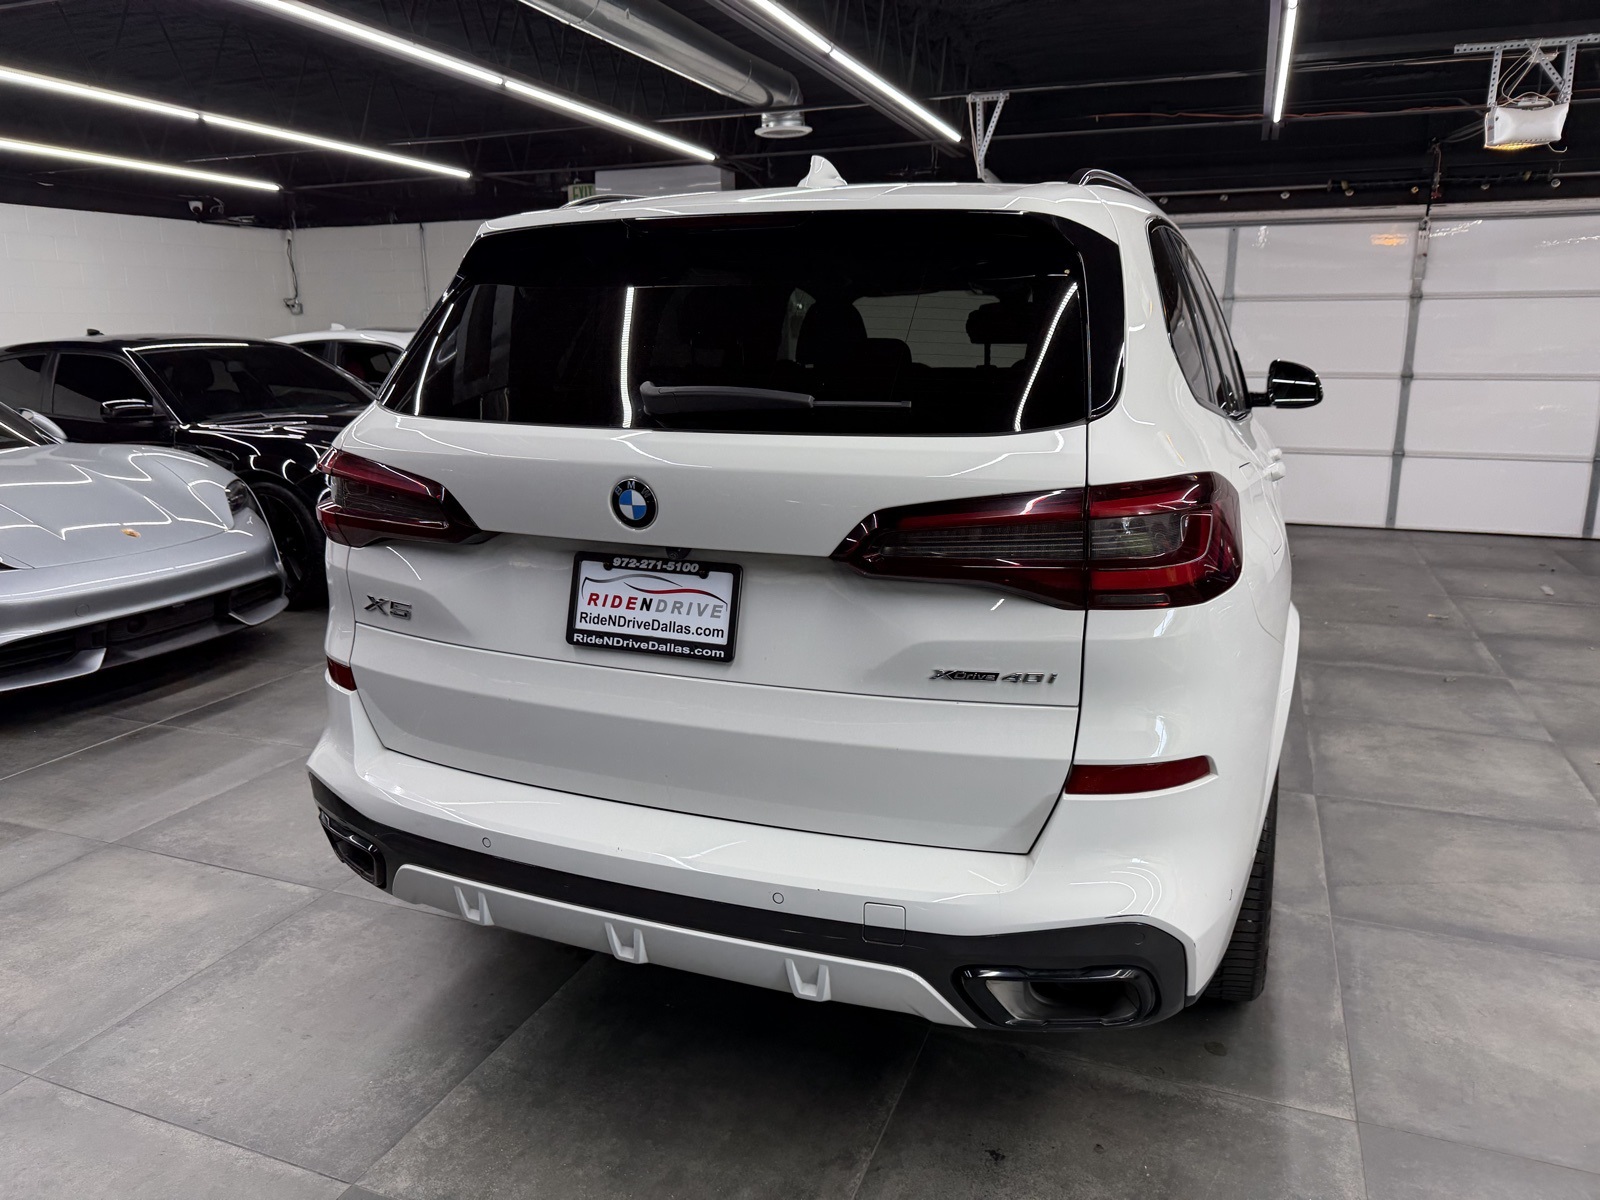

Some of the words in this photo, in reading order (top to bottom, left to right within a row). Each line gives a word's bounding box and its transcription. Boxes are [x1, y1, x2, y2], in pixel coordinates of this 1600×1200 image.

[573, 185, 593, 199] EXIT
[614, 480, 651, 498] BMW
[612, 557, 699, 573] 972-271-5100
[364, 594, 412, 621] X5
[587, 592, 723, 619] RIDENDRIVE
[579, 611, 724, 639] RideNDriveDallas.com
[573, 633, 725, 658] RideNDriveDallas.com
